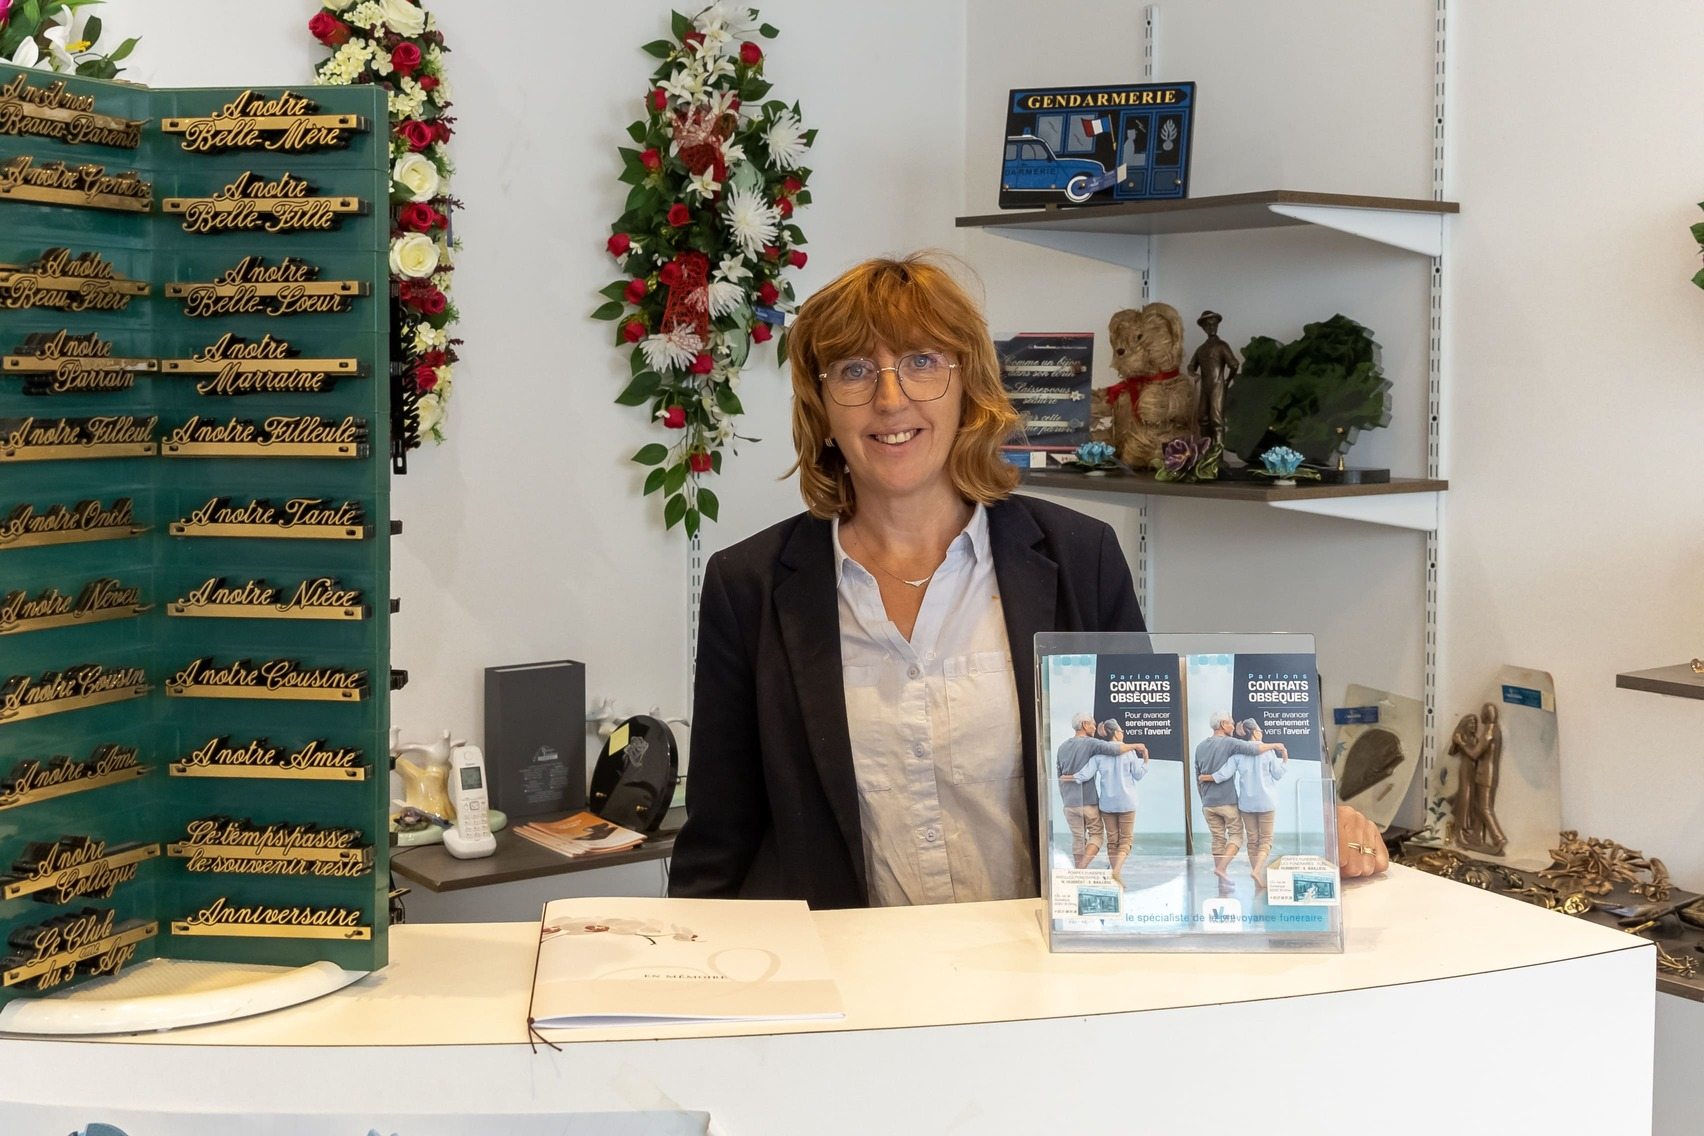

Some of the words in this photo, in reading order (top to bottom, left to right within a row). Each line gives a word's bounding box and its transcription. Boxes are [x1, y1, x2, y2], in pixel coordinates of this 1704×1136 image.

[211, 90, 252, 121] A
[247, 90, 308, 117] notre
[1027, 90, 1176, 109] GENDARMERIE
[0, 156, 33, 187] A
[27, 161, 79, 190] notre
[213, 170, 251, 201] A
[247, 172, 308, 198] notre
[37, 248, 71, 278] A
[65, 252, 114, 279] notre
[213, 255, 251, 287] A
[247, 256, 308, 283] notre
[35, 329, 67, 360] A
[63, 332, 112, 357] notre
[192, 332, 233, 362] A
[226, 333, 289, 359] notre
[54, 360, 135, 392] Parrain
[196, 362, 325, 393] Marraine
[0, 416, 34, 448] A
[29, 418, 80, 445] notre
[81, 415, 158, 448] Filleul
[161, 415, 200, 444] A
[194, 417, 255, 443] notre
[257, 415, 357, 446] Filleule
[0, 505, 33, 537] A
[28, 506, 80, 532] notre
[180, 496, 219, 527] A
[214, 499, 275, 524] notre
[278, 498, 357, 529] Tante
[0, 591, 27, 623] A
[22, 589, 73, 618] notre
[178, 577, 218, 607] A
[212, 579, 274, 605] notre
[275, 577, 357, 612] Nièce
[0, 677, 31, 712] A
[25, 673, 76, 704] notre
[78, 665, 145, 698] Cousin
[165, 658, 203, 687] A
[198, 660, 258, 686] notre
[260, 660, 359, 691] Cousine
[1110, 681, 1171, 691] CONTRATS
[1248, 680, 1309, 691] CONTRATS
[1110, 691, 1171, 705] OBSÈQUES
[1248, 690, 1309, 704] OBSÈQUES
[1124, 711, 1141, 719] Pour
[1125, 719, 1171, 727] sereinement
[1263, 710, 1280, 718] Pour
[1263, 718, 1309, 727] sereinement
[1144, 727, 1171, 735] l'avenir
[1283, 726, 1311, 735] l'avenir
[180, 737, 219, 768] A
[214, 740, 276, 765] notre
[279, 740, 357, 770] Amie
[4, 761, 41, 797] A
[34, 757, 84, 787] notre
[86, 745, 138, 779] Ami
[219, 822, 285, 855] temps
[284, 825, 350, 856] passe
[28, 842, 60, 880] A
[57, 836, 105, 868] notre
[211, 857, 307, 875] souvenir
[310, 853, 364, 877] reste
[56, 860, 138, 904] Collègue
[186, 897, 361, 926] Anniversaire
[1125, 913, 1134, 922] le
[1137, 912, 1190, 926] spécialiste
[1193, 913, 1205, 922] de
[26, 927, 61, 967] Le
[63, 909, 116, 953] Club
[37, 960, 62, 991] du
[90, 936, 136, 976] Age
